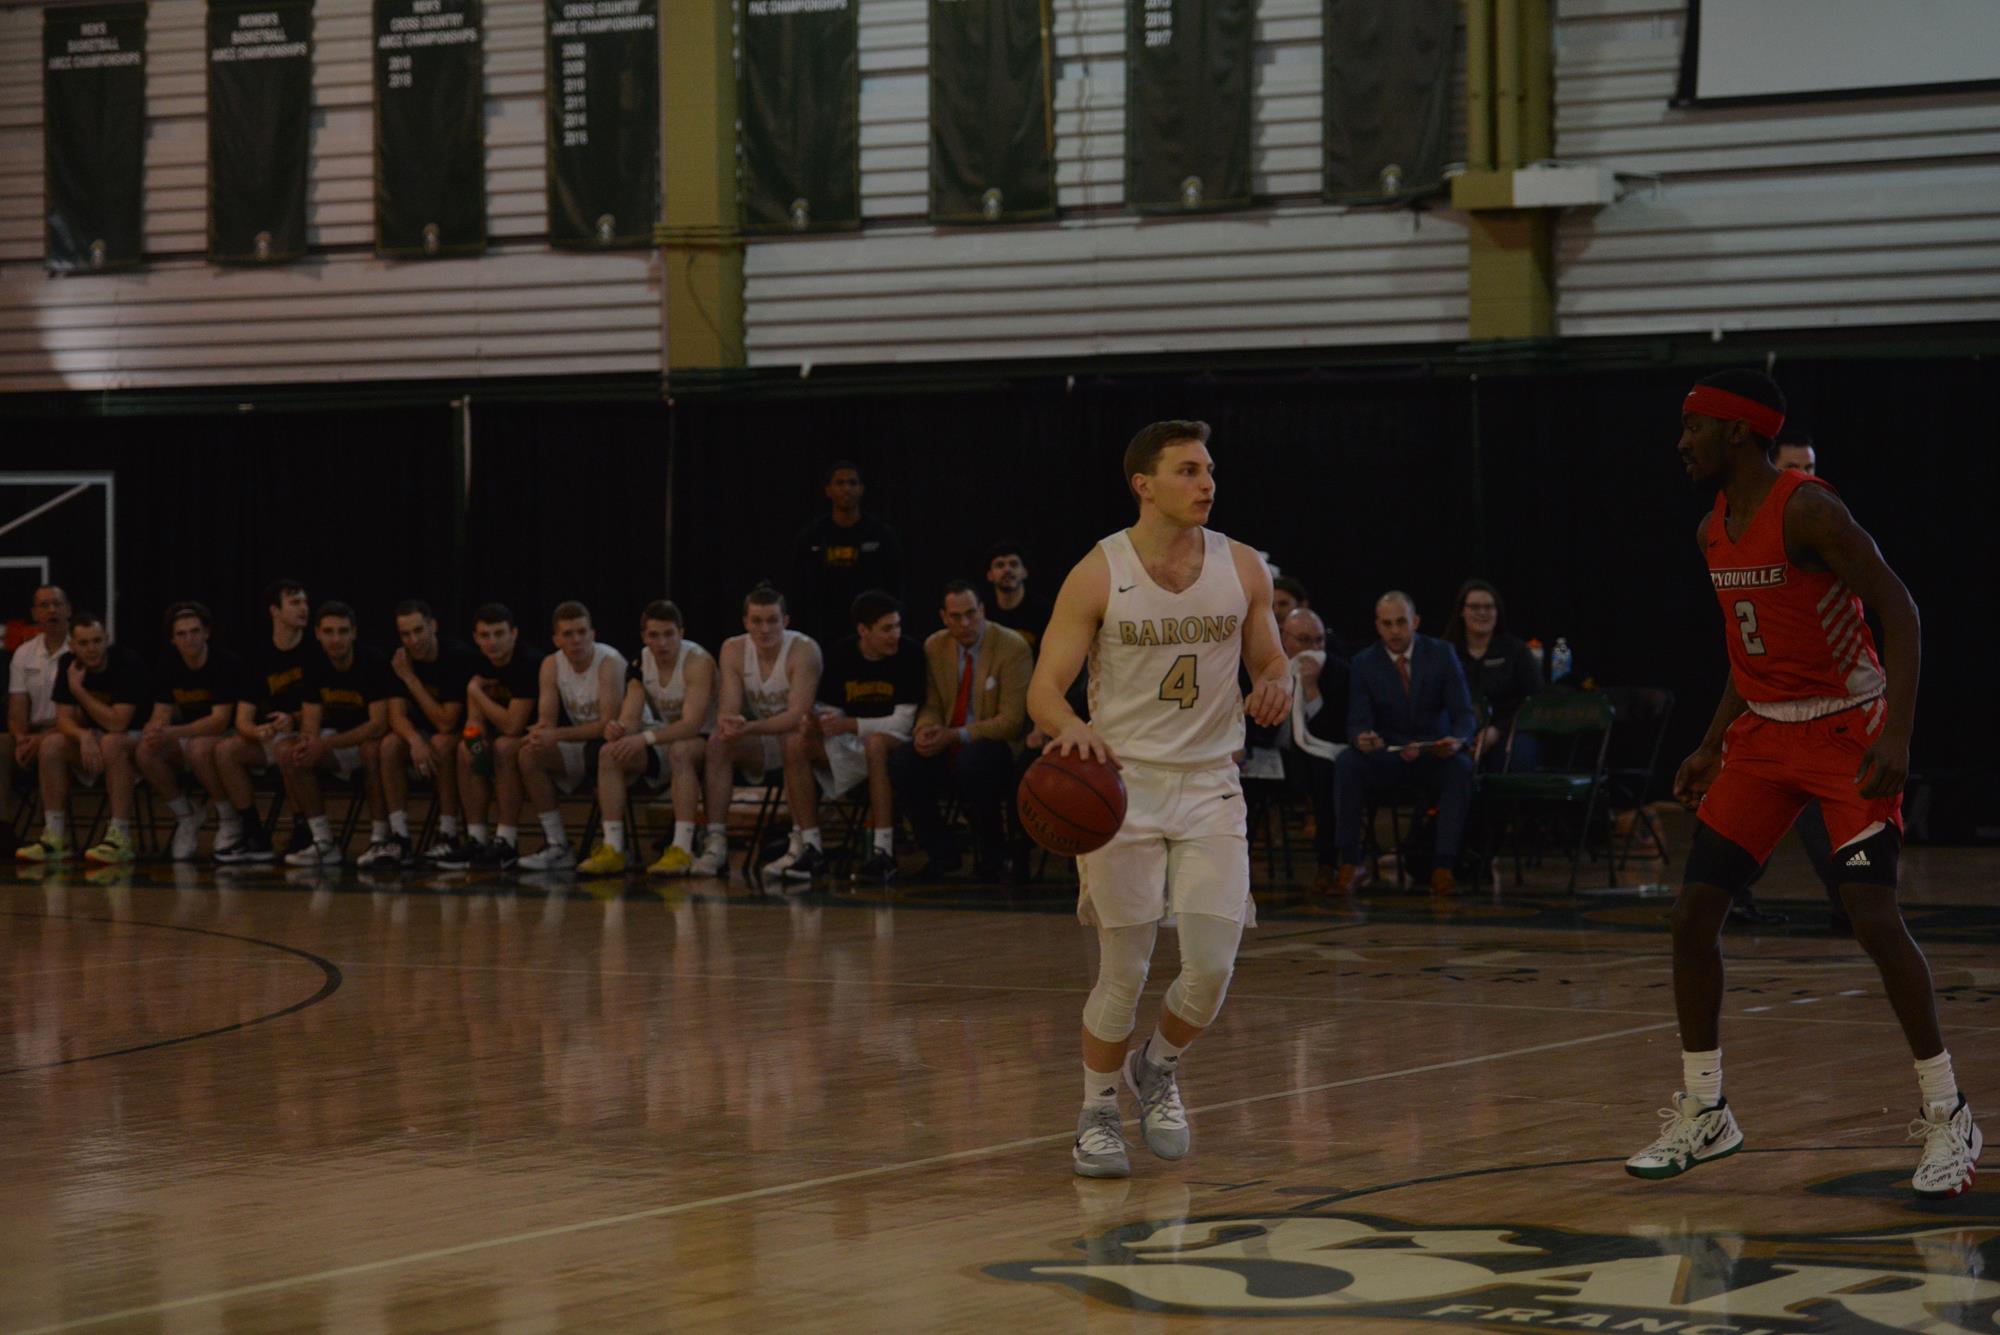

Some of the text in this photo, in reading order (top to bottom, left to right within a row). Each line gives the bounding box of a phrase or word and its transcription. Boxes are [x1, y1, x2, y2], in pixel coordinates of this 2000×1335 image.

[563, 0, 639, 18] CROSS COUNTRY
[421, 13, 464, 29] COUNTRY
[578, 14, 656, 33] CHAMPIONSHIPS
[404, 27, 477, 46] CHAMPIONSHIPS
[73, 51, 140, 68] CHAMPIONSHIPS
[236, 42, 308, 59] CHAMPIONSHIPS
[1119, 615, 1238, 646] BARONS
[1734, 599, 1767, 656] 2
[1159, 654, 1199, 710] 4
[1030, 1217, 2000, 1335] BAR
